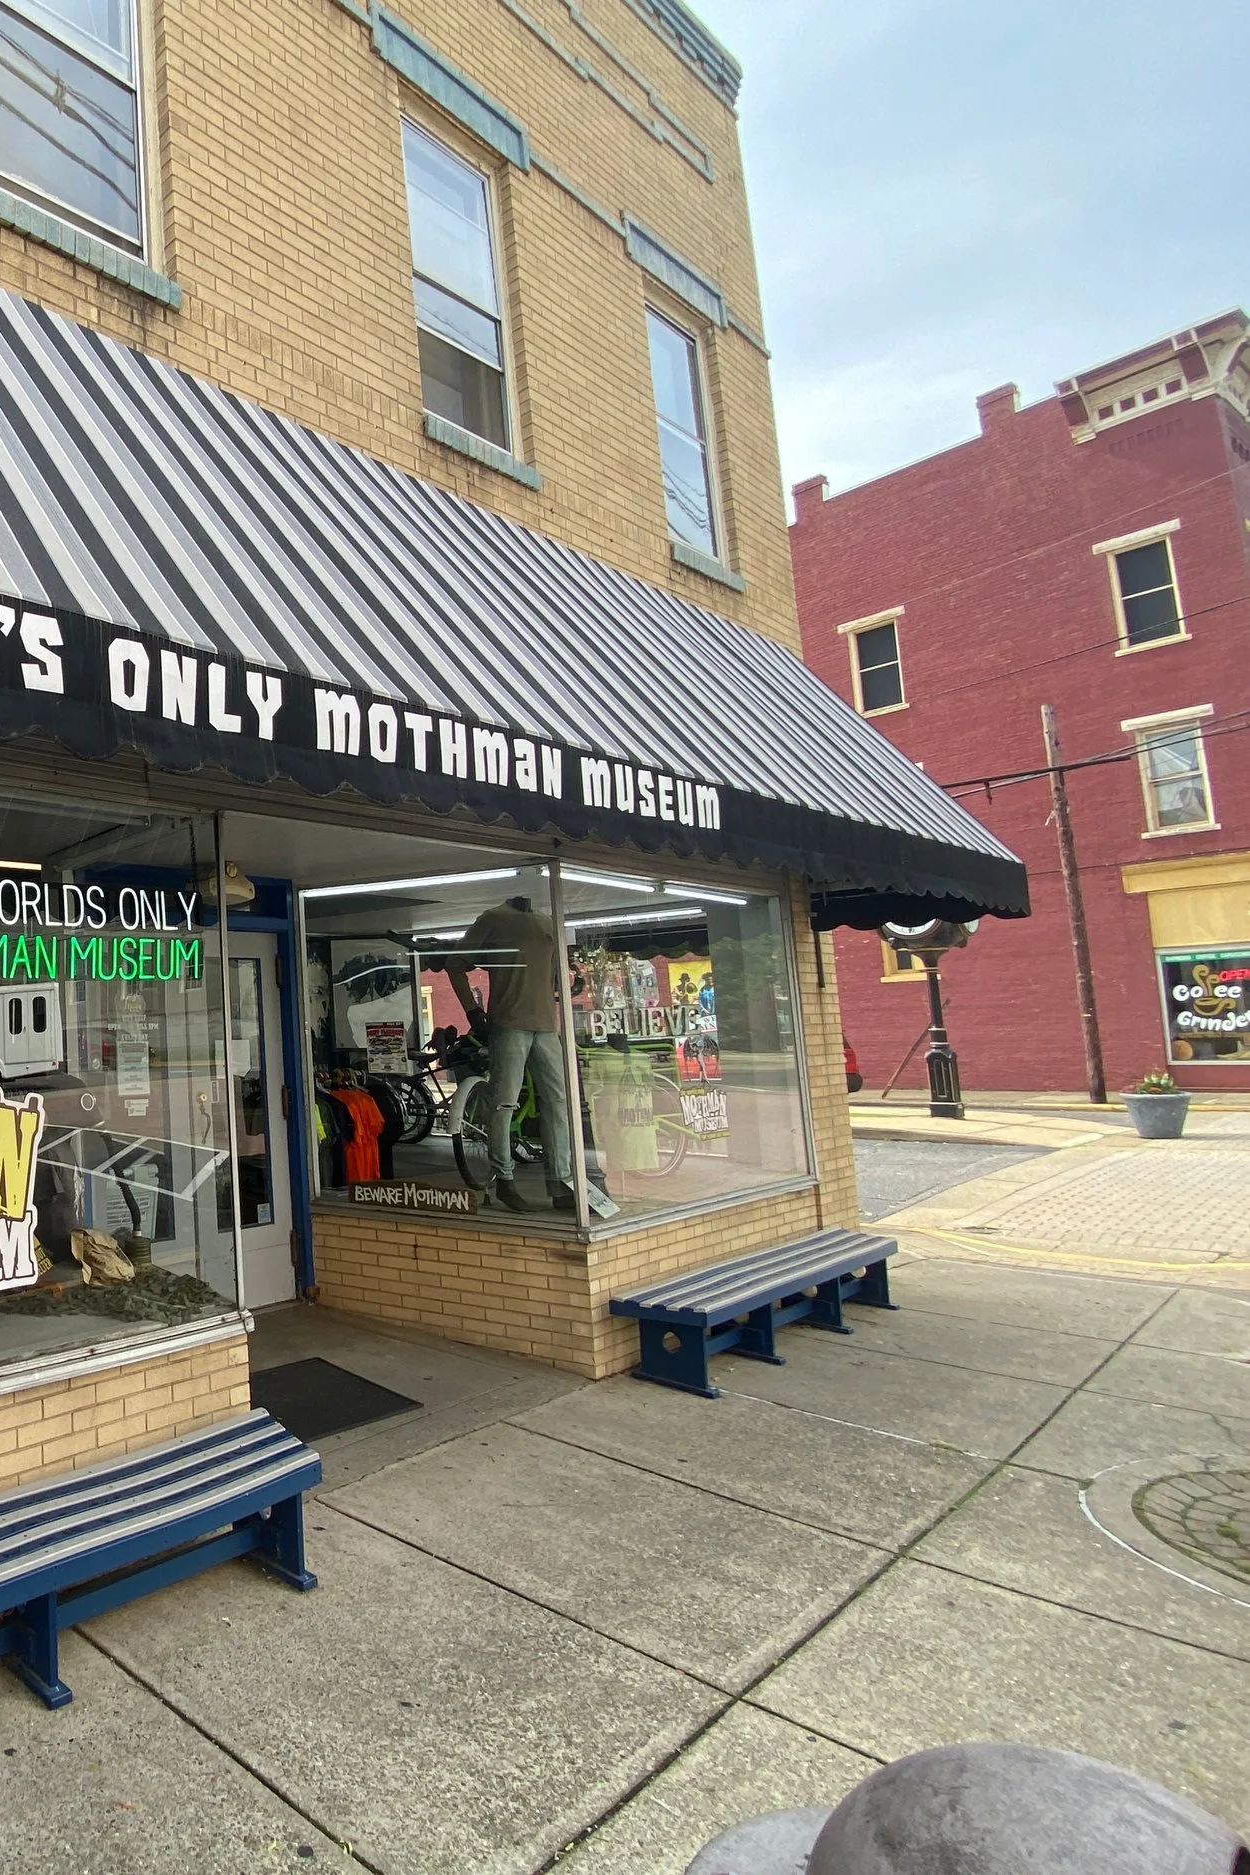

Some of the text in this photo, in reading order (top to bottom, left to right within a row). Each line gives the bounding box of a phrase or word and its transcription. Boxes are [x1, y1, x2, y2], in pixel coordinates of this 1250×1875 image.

[107, 636, 282, 741] ONLY
[313, 687, 563, 799] MOTHMAN
[581, 756, 721, 830] MUSEUM
[119, 887, 198, 931] ONLY
[70, 936, 200, 980] MUSEUM
[591, 1004, 701, 1041] BELIEVE
[354, 1182, 470, 1210] BEWARE MOTHMAN
